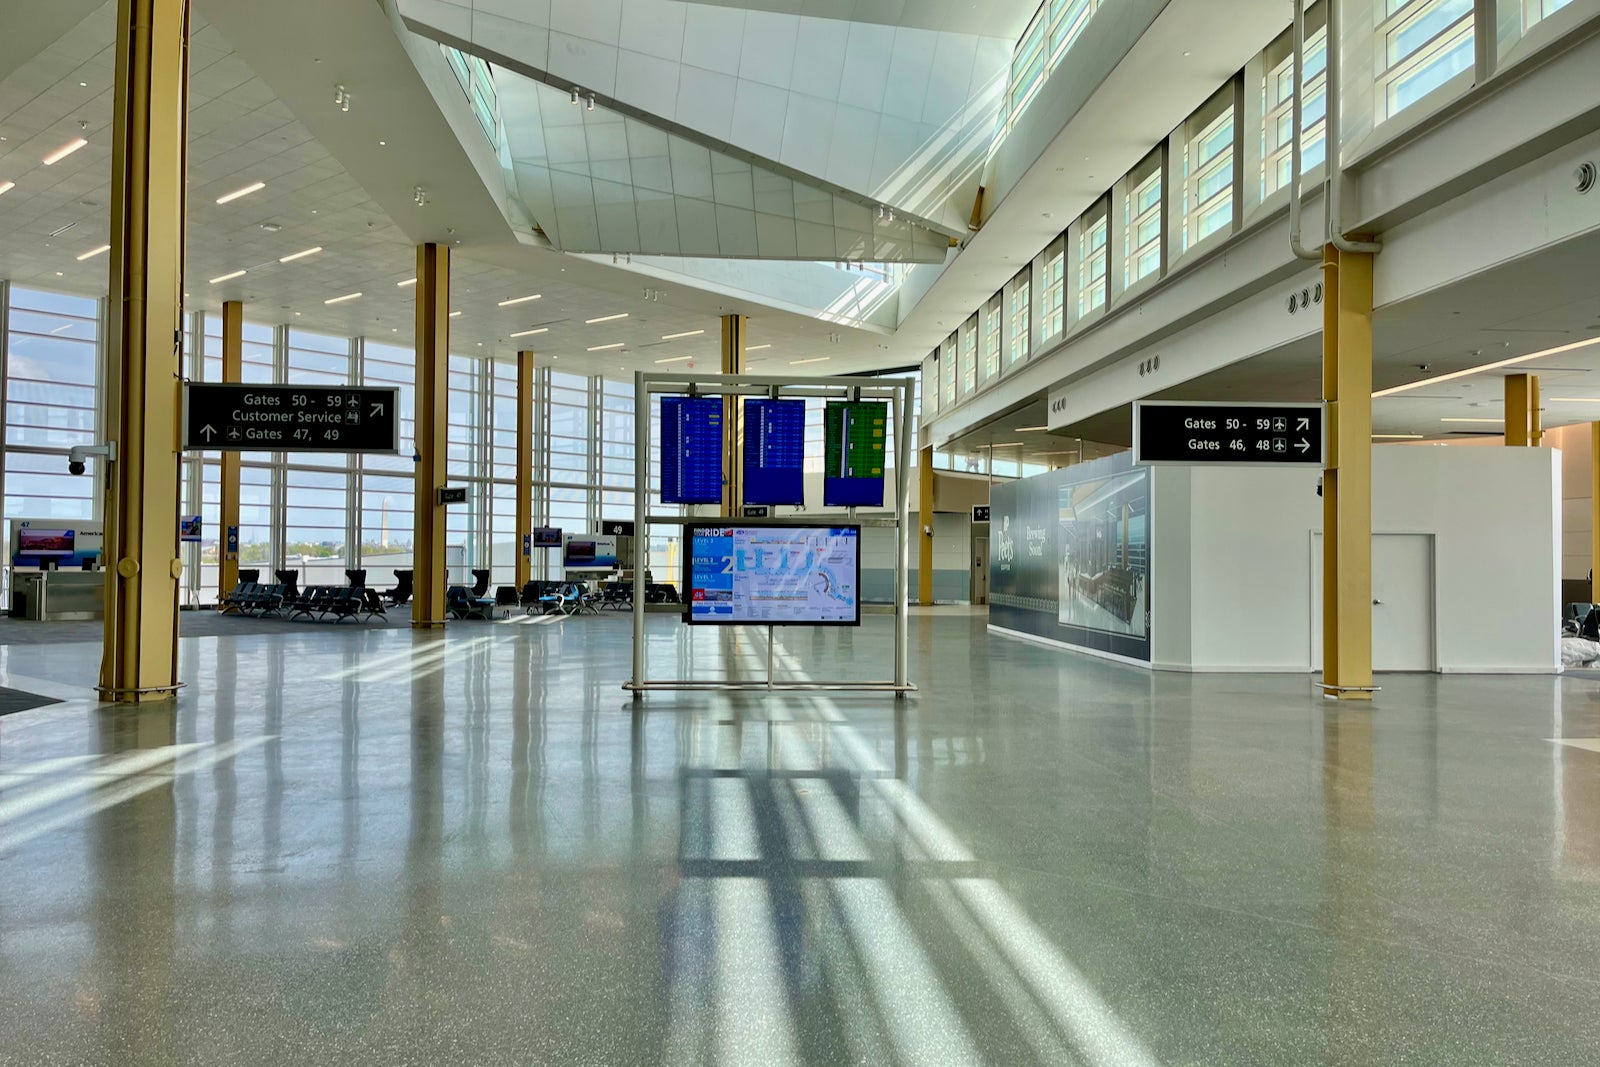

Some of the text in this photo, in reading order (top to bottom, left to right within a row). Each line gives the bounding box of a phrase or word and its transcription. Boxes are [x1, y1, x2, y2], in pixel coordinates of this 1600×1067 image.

[244, 394, 280, 406] Gates
[292, 395, 307, 406] 50
[327, 396, 342, 407] 59
[232, 410, 342, 423] Customer Service
[1184, 418, 1216, 429] Gates
[1226, 419, 1240, 429] 50
[1256, 419, 1270, 430] 59
[246, 428, 339, 442] Gates 47, 49
[1188, 439, 1270, 452] Gates 46, 48
[613, 525, 622, 535] 49
[705, 528, 725, 537] RIDE
[1026, 525, 1046, 543] Brewing
[721, 556, 733, 574] 2
